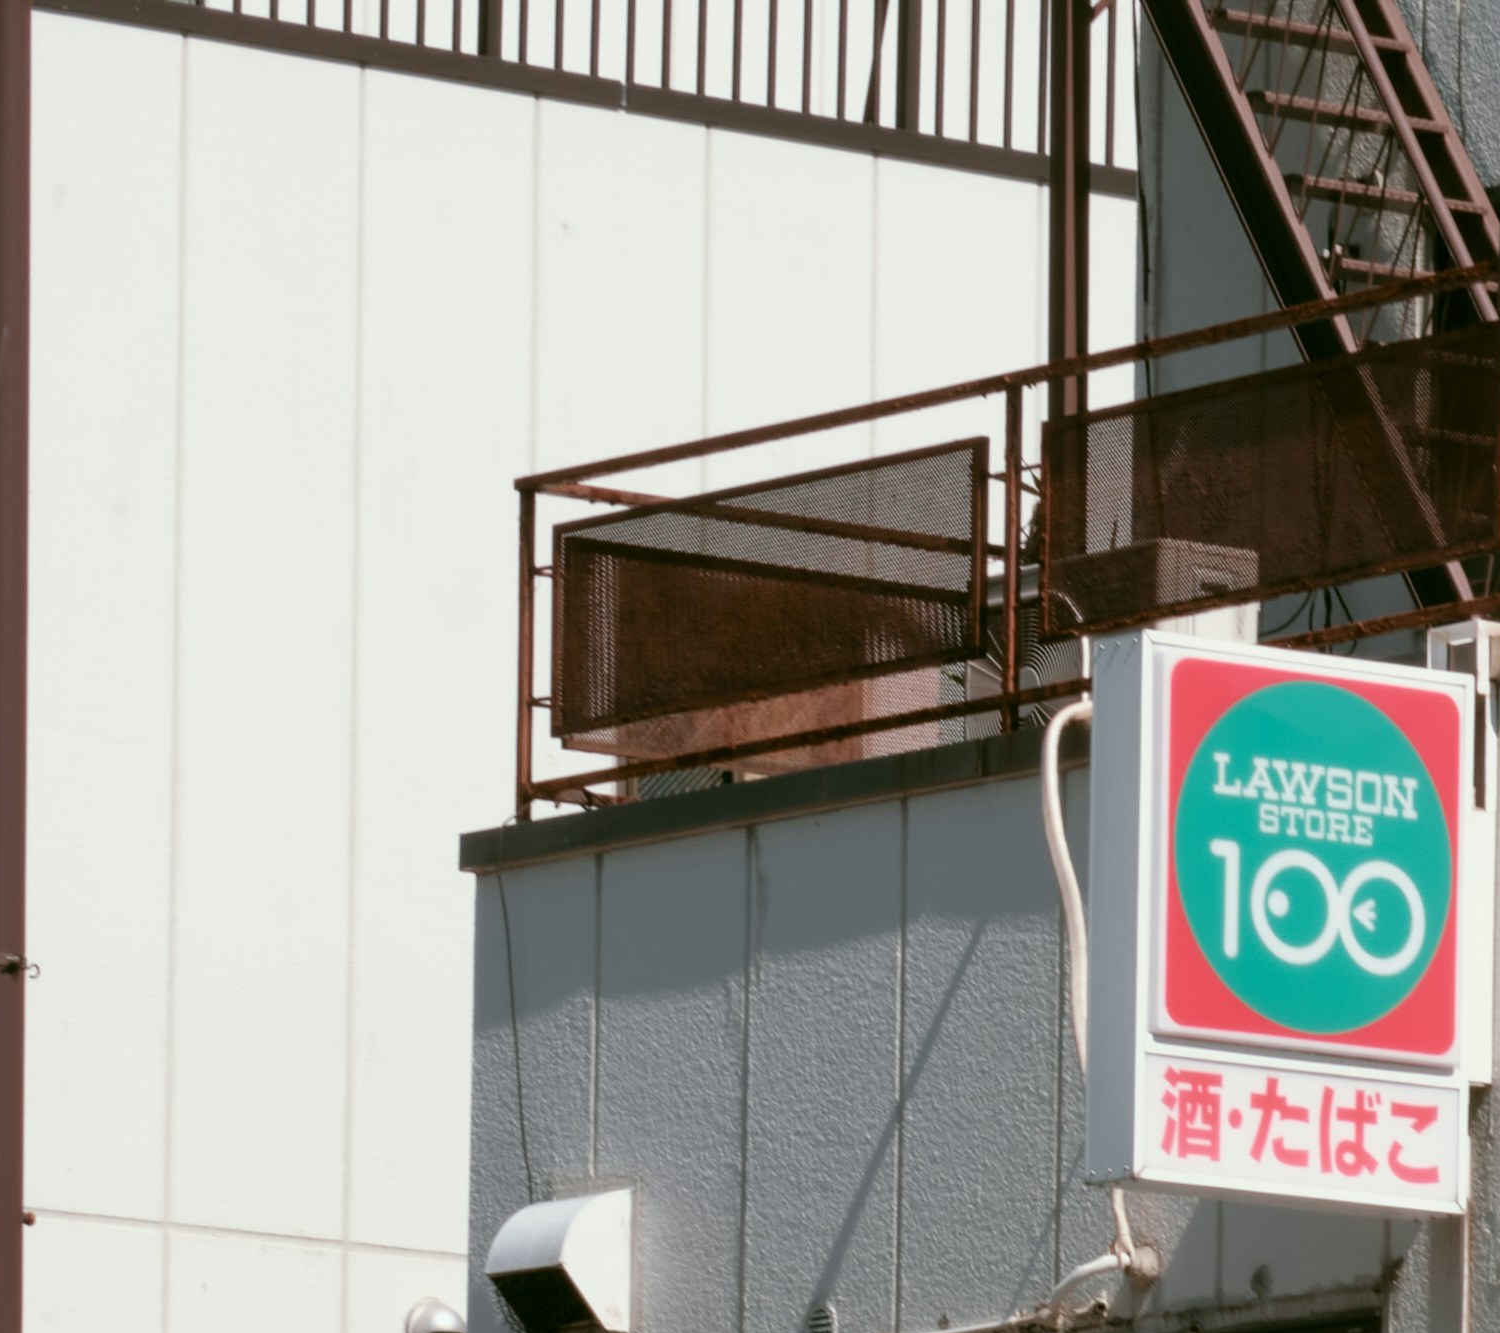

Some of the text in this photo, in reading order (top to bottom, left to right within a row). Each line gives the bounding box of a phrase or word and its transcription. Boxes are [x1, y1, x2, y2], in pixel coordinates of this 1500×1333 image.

[1210, 752, 1418, 821] LAWSON
[1258, 806, 1374, 846] STORE
[1209, 838, 1426, 977] 100
[1160, 1064, 1441, 1185] 酒・たばこ
